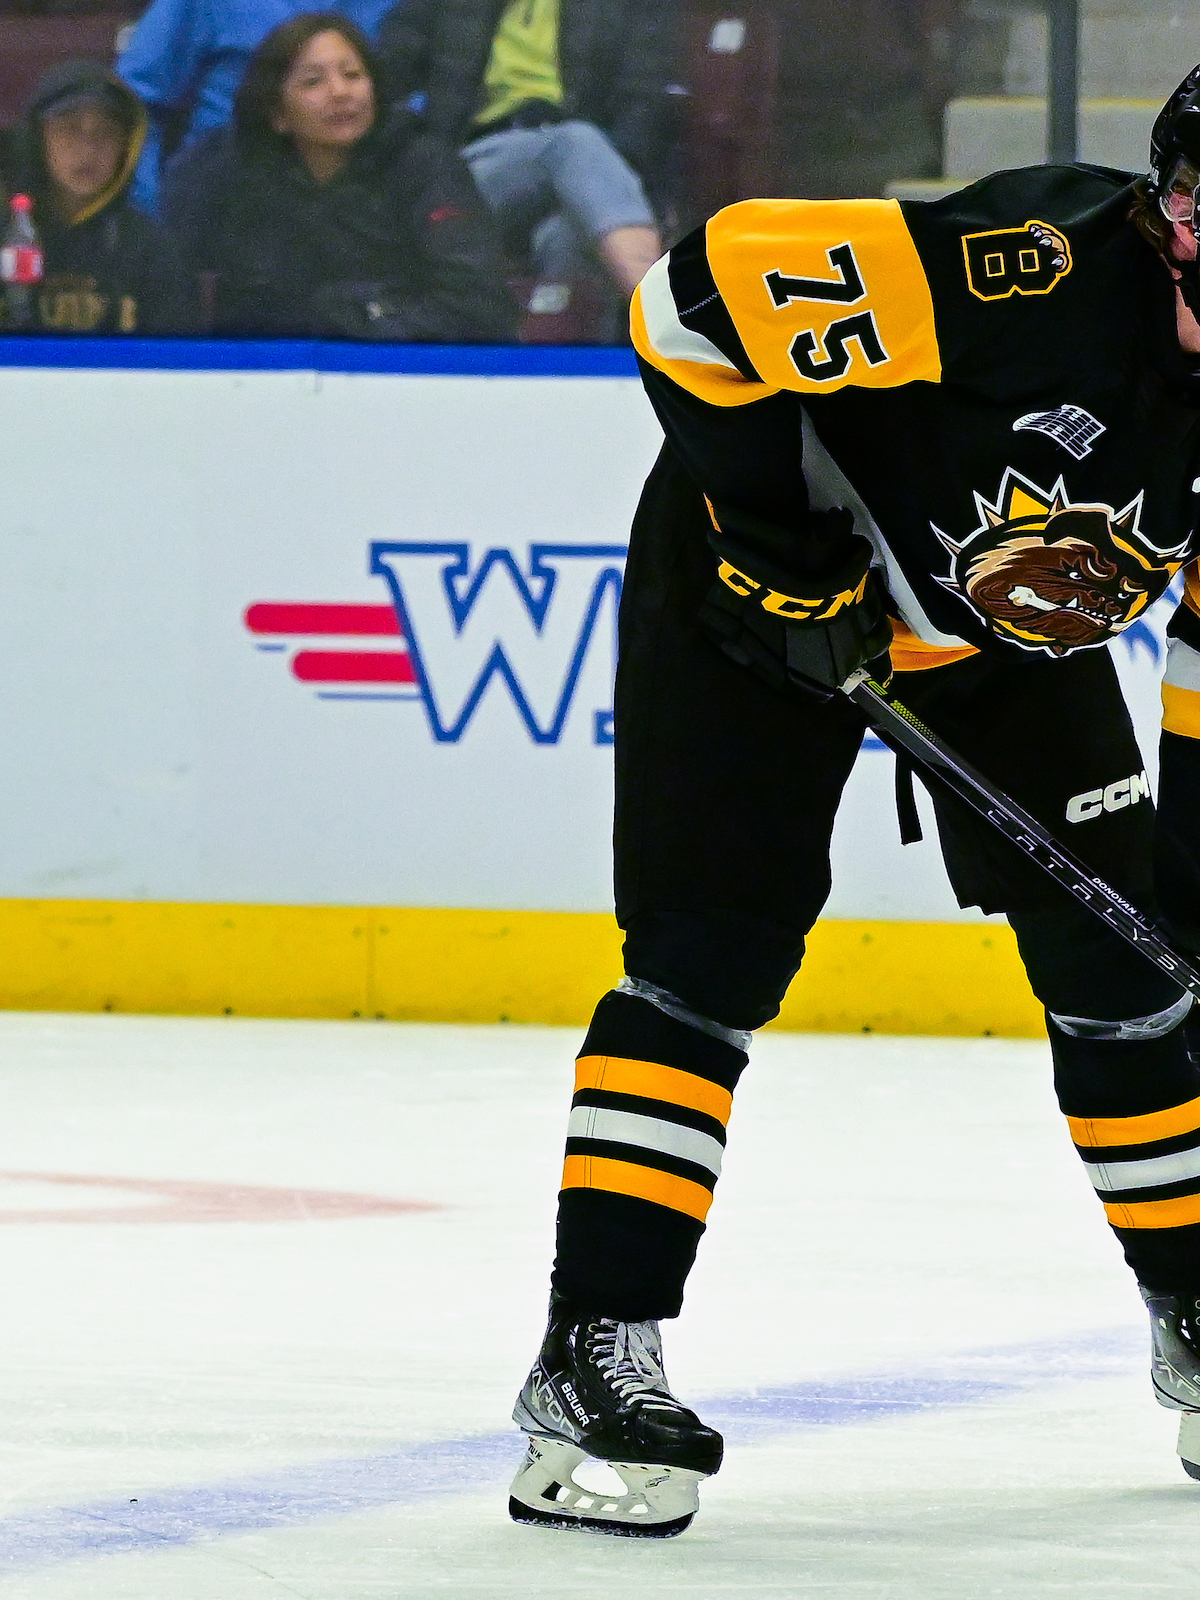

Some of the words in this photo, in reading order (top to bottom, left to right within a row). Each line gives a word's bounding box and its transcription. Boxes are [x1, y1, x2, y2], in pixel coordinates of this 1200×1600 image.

[762, 240, 892, 383] 75
[717, 556, 870, 621] CCM
[1066, 769, 1151, 824] CCM
[1092, 877, 1138, 915] DONOVAN
